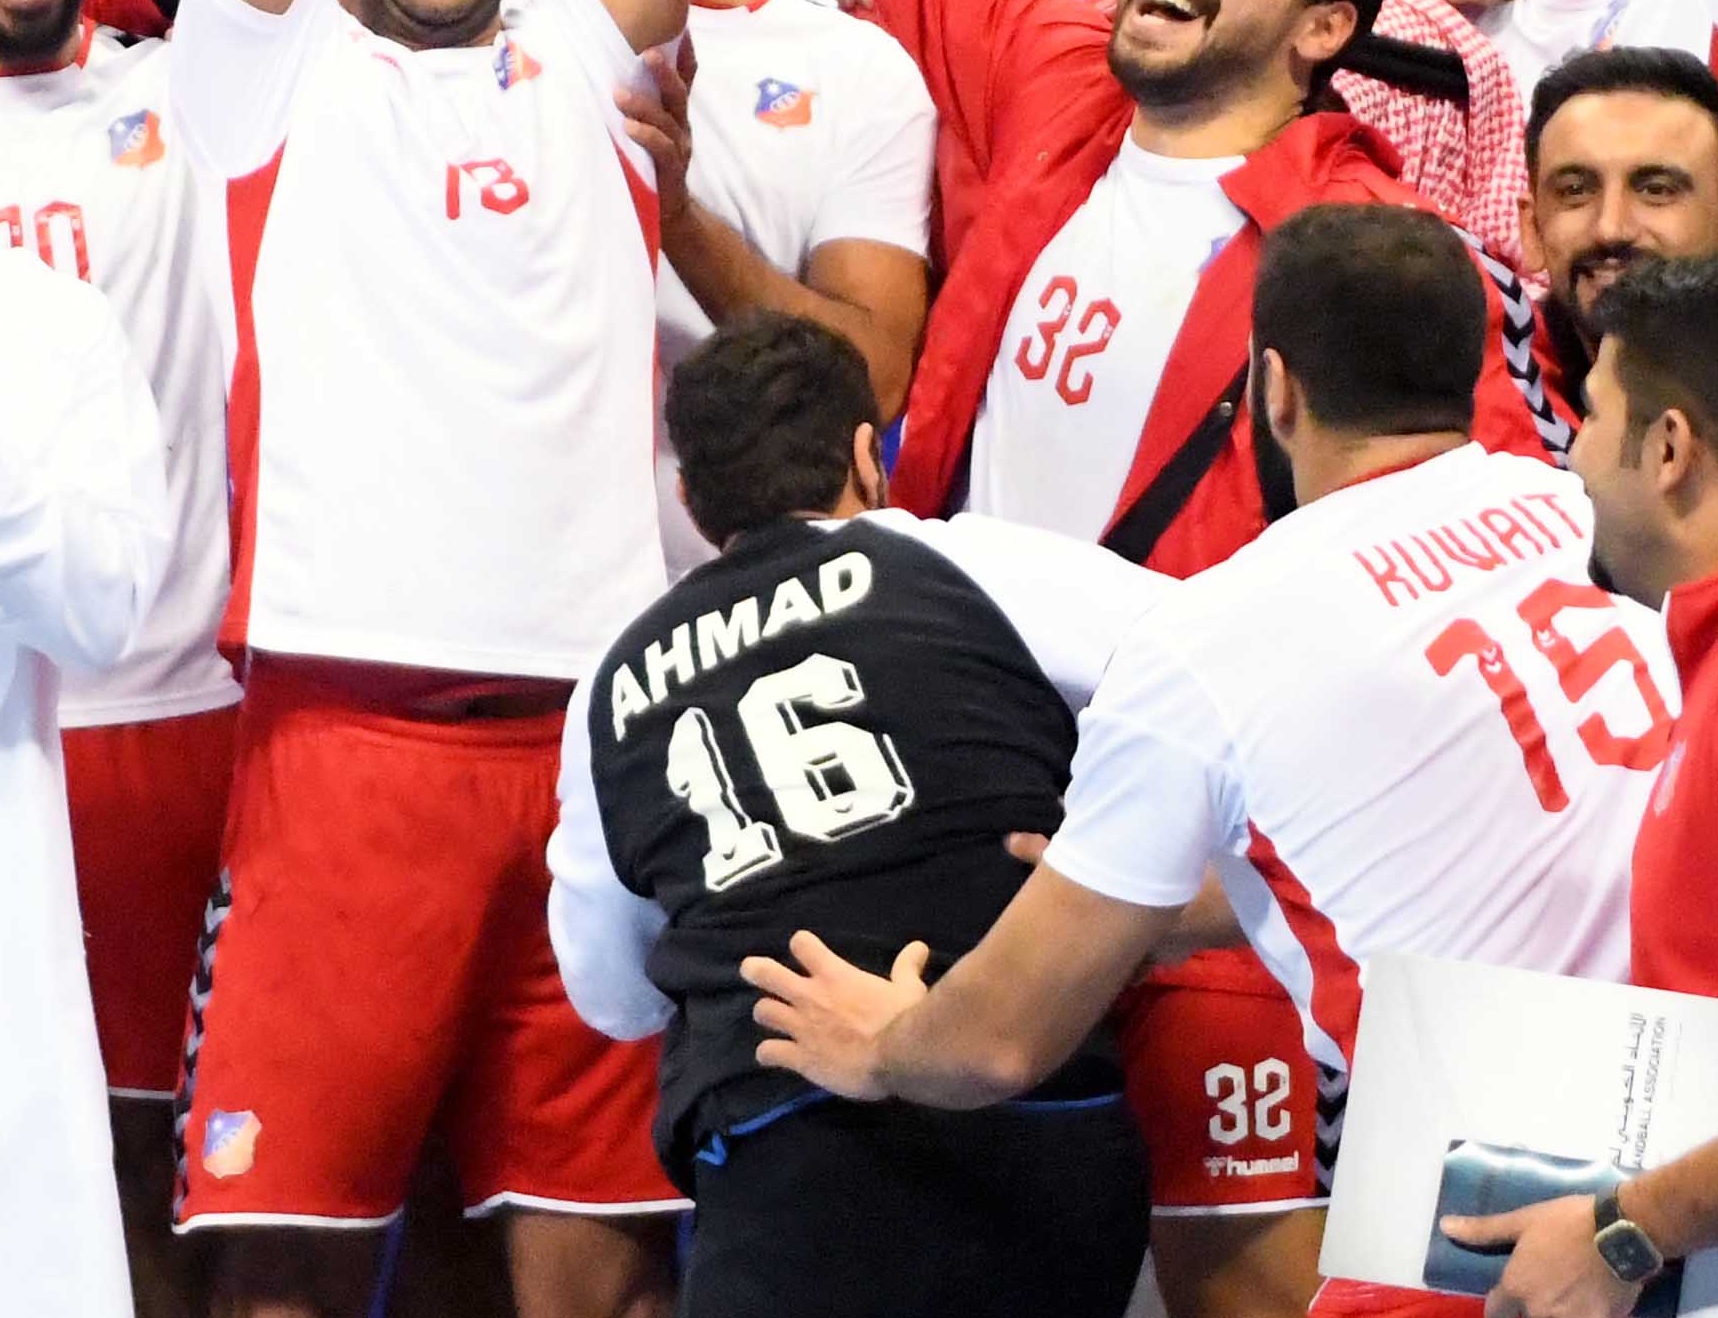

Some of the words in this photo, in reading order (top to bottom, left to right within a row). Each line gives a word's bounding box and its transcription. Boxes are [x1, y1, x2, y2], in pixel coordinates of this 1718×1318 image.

[1014, 274, 1122, 406] 32
[1352, 493, 1585, 608] KUWAIT
[610, 550, 874, 743] AHMAD
[665, 652, 916, 893] 16
[1204, 1057, 1292, 1146] 32
[1226, 1149, 1300, 1178] hummel
